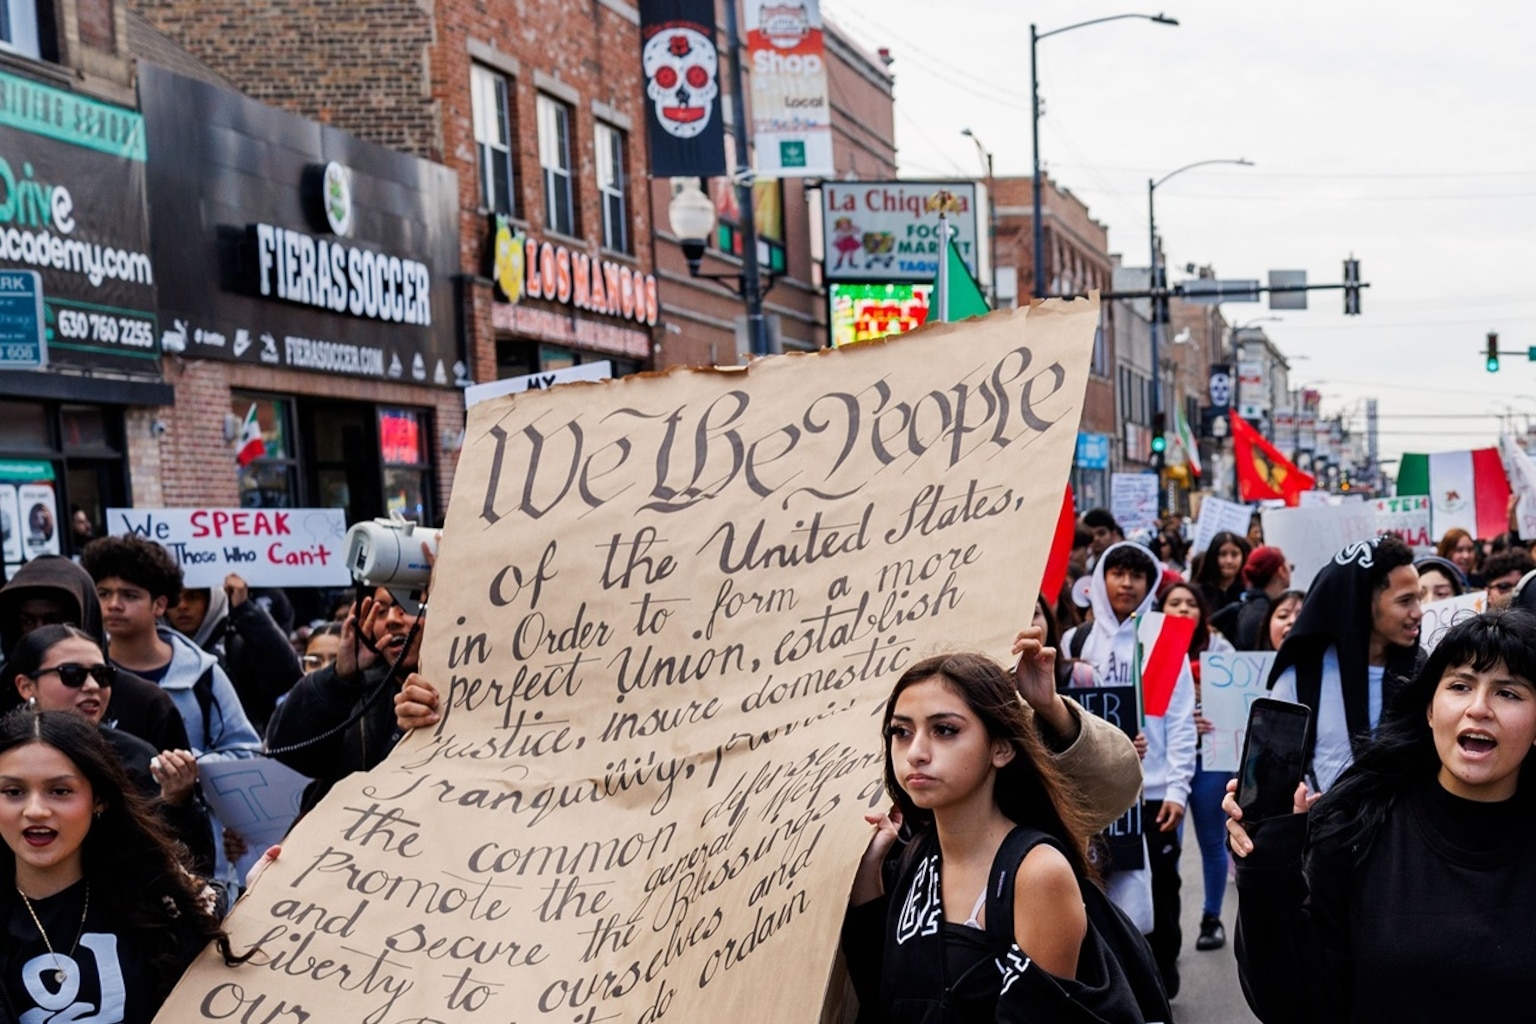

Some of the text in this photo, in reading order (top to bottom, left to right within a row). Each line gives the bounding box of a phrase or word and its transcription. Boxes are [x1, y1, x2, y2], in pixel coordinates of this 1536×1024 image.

[753, 49, 822, 74] Shop
[828, 189, 855, 212] La
[256, 223, 431, 327] FIERAS SOCCER
[526, 237, 658, 327] LOS MANGOS
[58, 309, 89, 338] 630
[119, 318, 154, 348] 2255
[527, 373, 556, 389] MY
[478, 404, 634, 527] We
[600, 388, 802, 516] the
[784, 344, 1075, 510] People
[121, 511, 291, 540] We SPEAK
[488, 538, 559, 611] of
[595, 526, 679, 590] the
[696, 502, 871, 575] United
[884, 477, 1025, 545] States,
[434, 570, 966, 737] perfect Union, establish
[448, 543, 984, 669] in Order to form a more
[597, 695, 723, 744] insure
[740, 635, 917, 714] domestic
[1208, 655, 1267, 688] SOY
[343, 803, 424, 858] the
[467, 820, 678, 877] common
[533, 875, 617, 923] the
[627, 806, 751, 925] general
[269, 898, 370, 938] and
[384, 922, 551, 968] secure
[577, 913, 645, 963] the
[441, 966, 505, 1013] to
[536, 906, 723, 1013] ourselves
[748, 822, 828, 908] and
[698, 881, 811, 990] ordain
